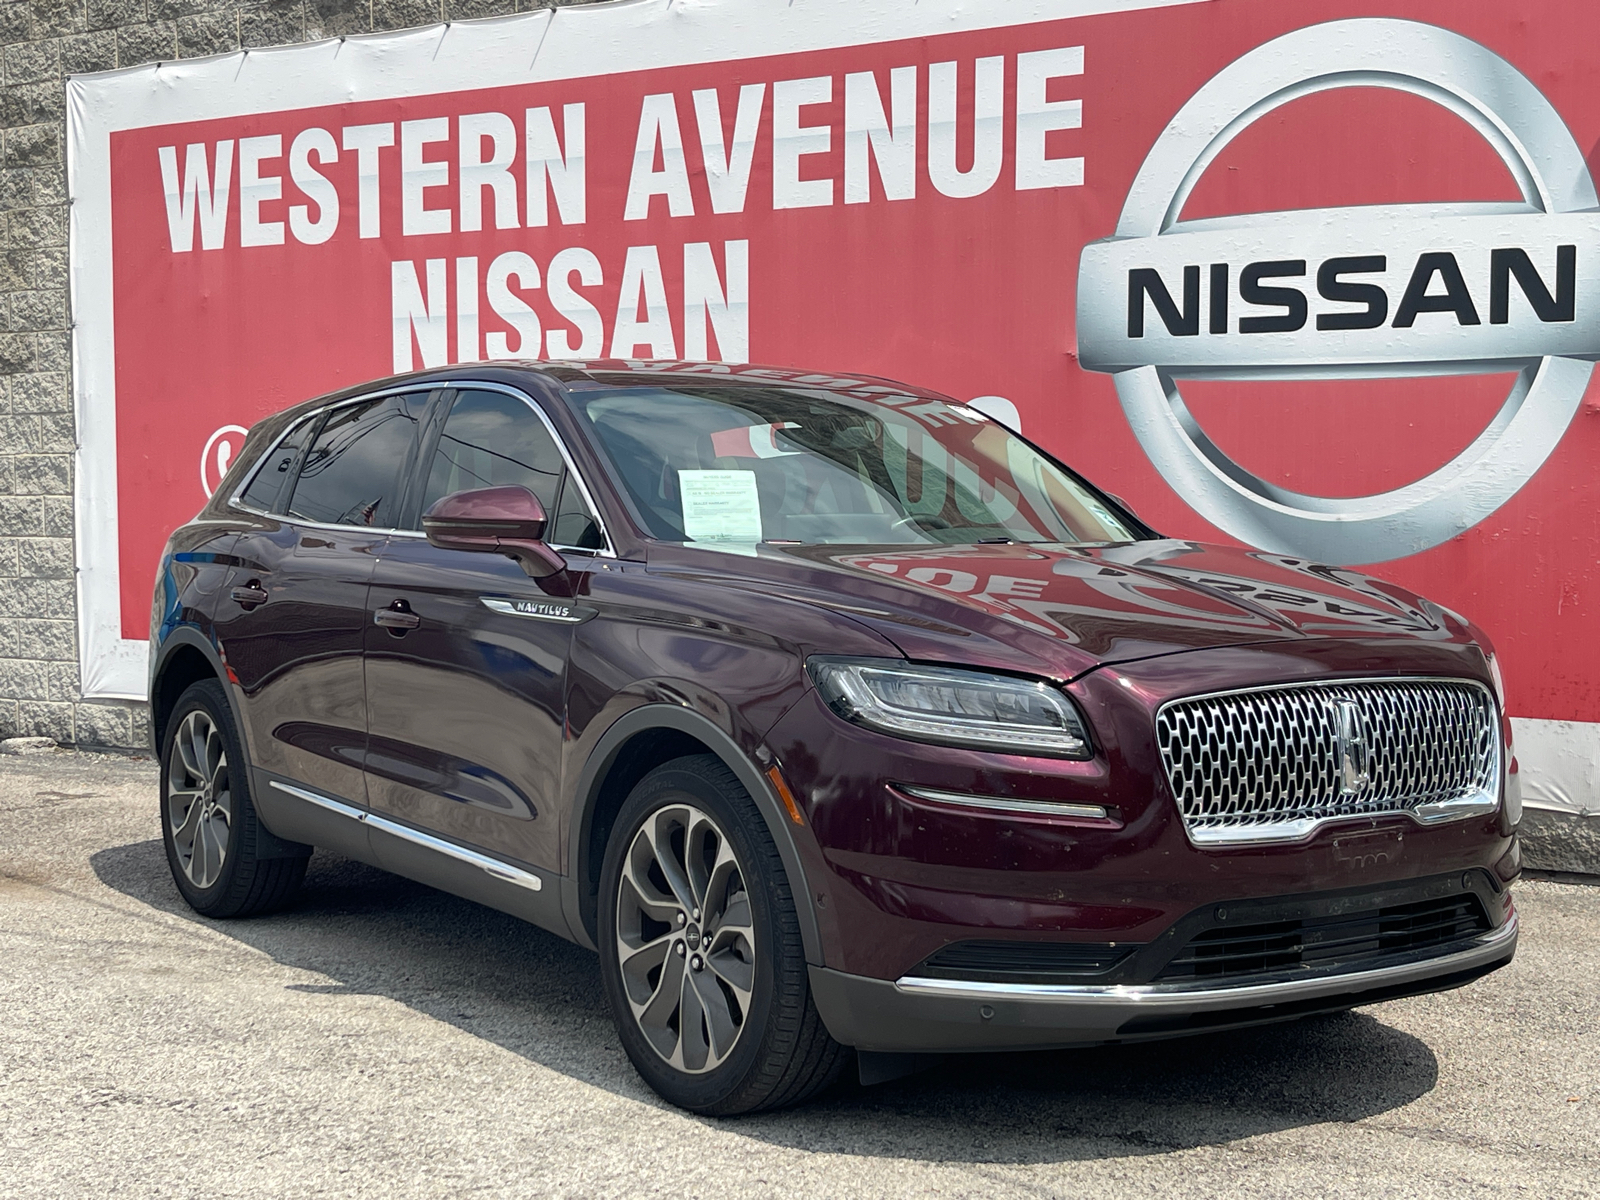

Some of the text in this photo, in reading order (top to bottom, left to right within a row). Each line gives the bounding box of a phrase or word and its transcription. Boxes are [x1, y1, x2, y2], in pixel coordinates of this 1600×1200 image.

[158, 45, 1085, 254] WESTERN AVENUE
[391, 239, 749, 375] NISSAN
[1128, 245, 1576, 338] NISSAN
[516, 602, 570, 617] NAUTILUS
